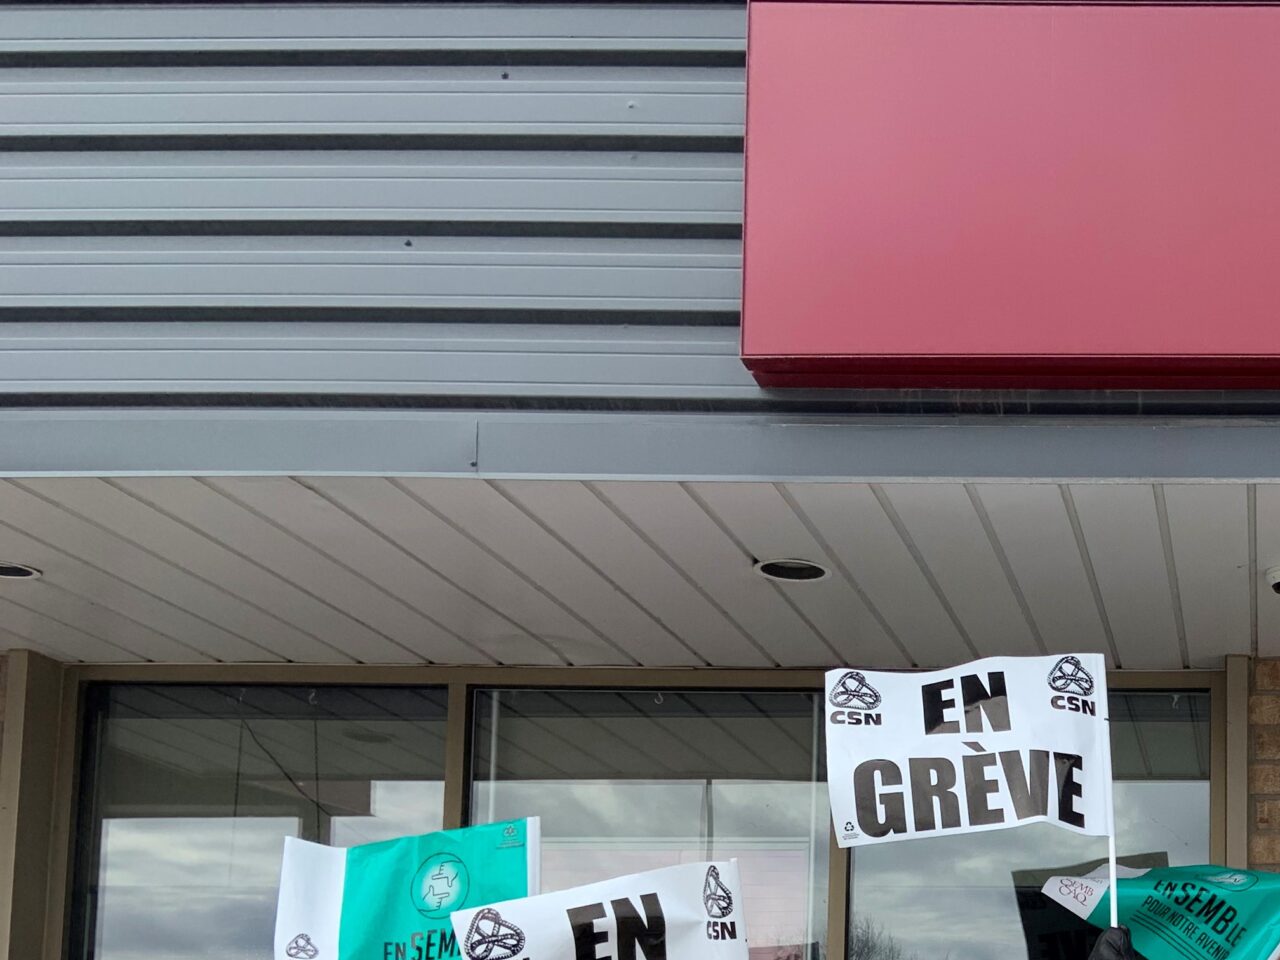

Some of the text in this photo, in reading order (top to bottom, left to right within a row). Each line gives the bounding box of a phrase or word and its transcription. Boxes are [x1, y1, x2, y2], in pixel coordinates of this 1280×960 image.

[829, 711, 882, 726] CSN
[921, 671, 1011, 735] EN
[1051, 695, 1096, 716] CSN
[853, 741, 1085, 838] GRÈVE
[707, 921, 737, 940] CSN
[1142, 895, 1172, 918] POUR
[1168, 911, 1199, 940] NOTRE
